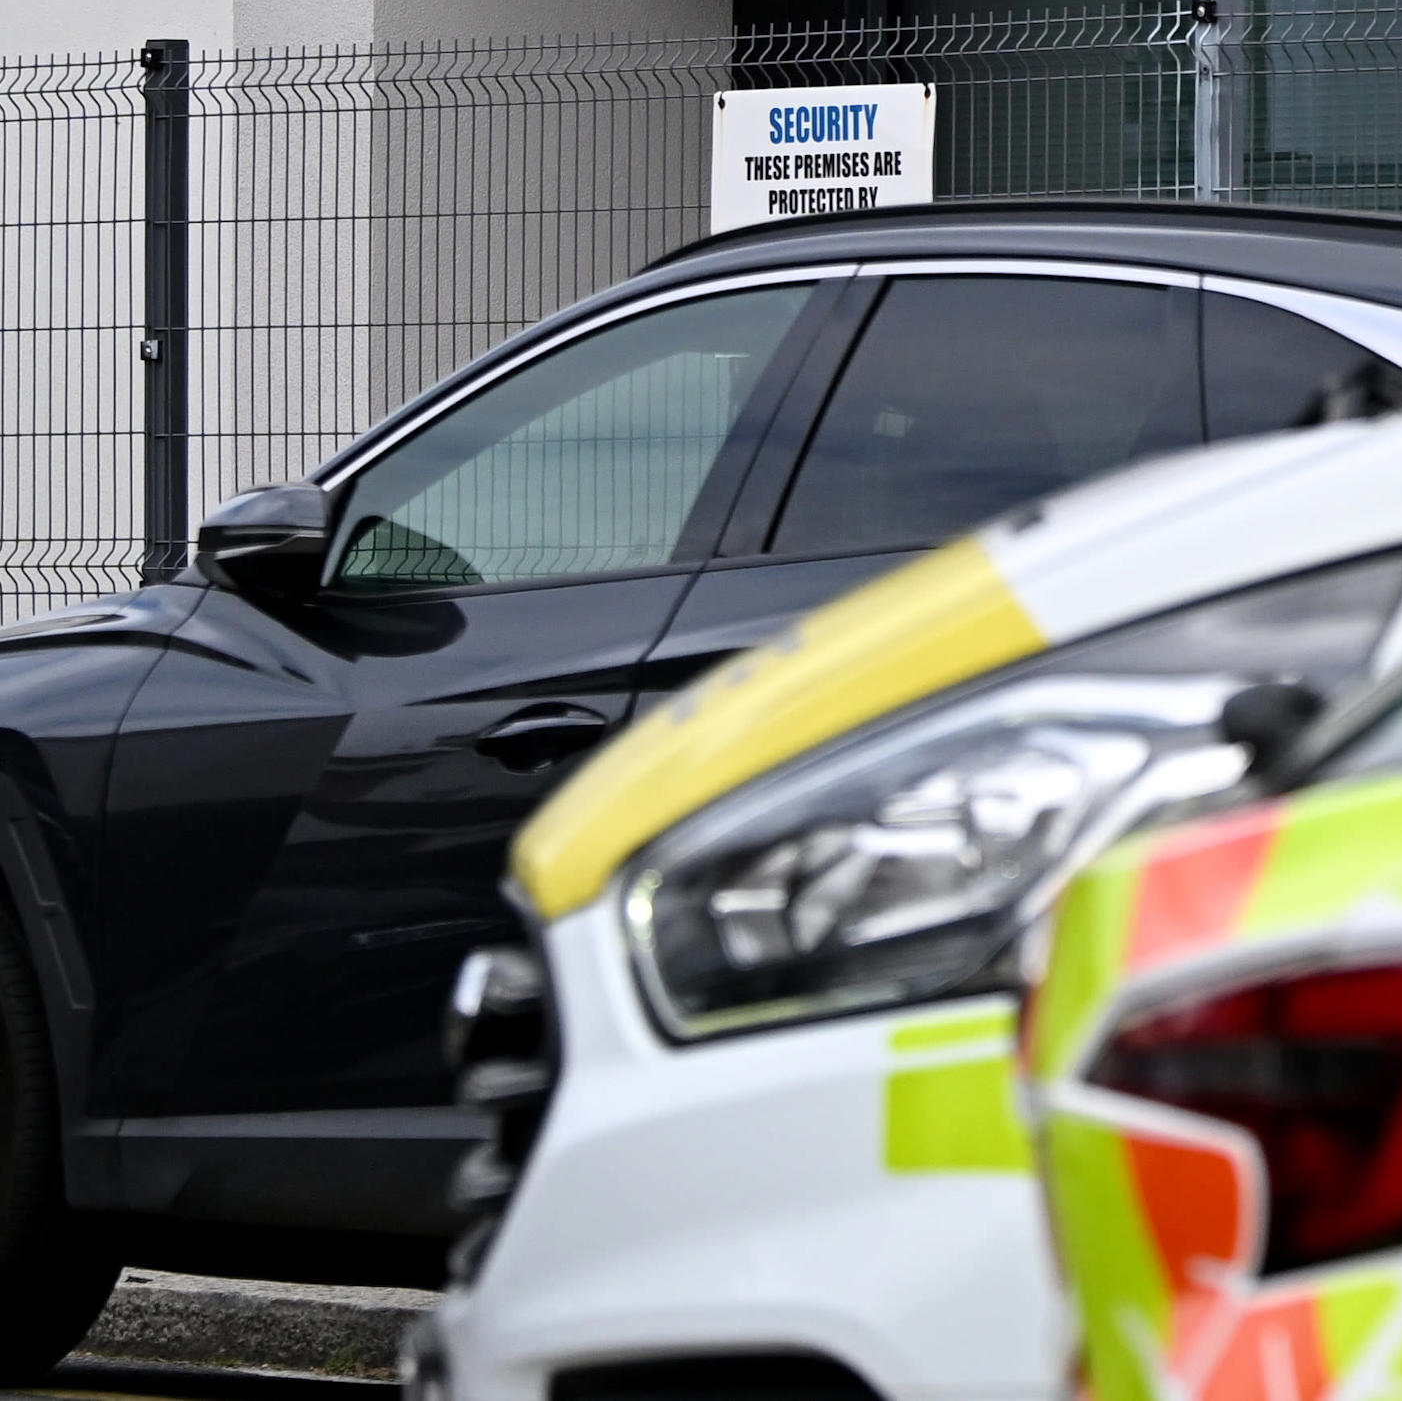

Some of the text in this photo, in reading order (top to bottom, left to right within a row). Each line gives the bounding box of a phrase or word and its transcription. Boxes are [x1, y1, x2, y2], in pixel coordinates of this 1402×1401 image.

[769, 103, 878, 145] SECURITY
[744, 151, 902, 181] THESE PREMISES ARE
[768, 186, 879, 215] PROTECTED BY
